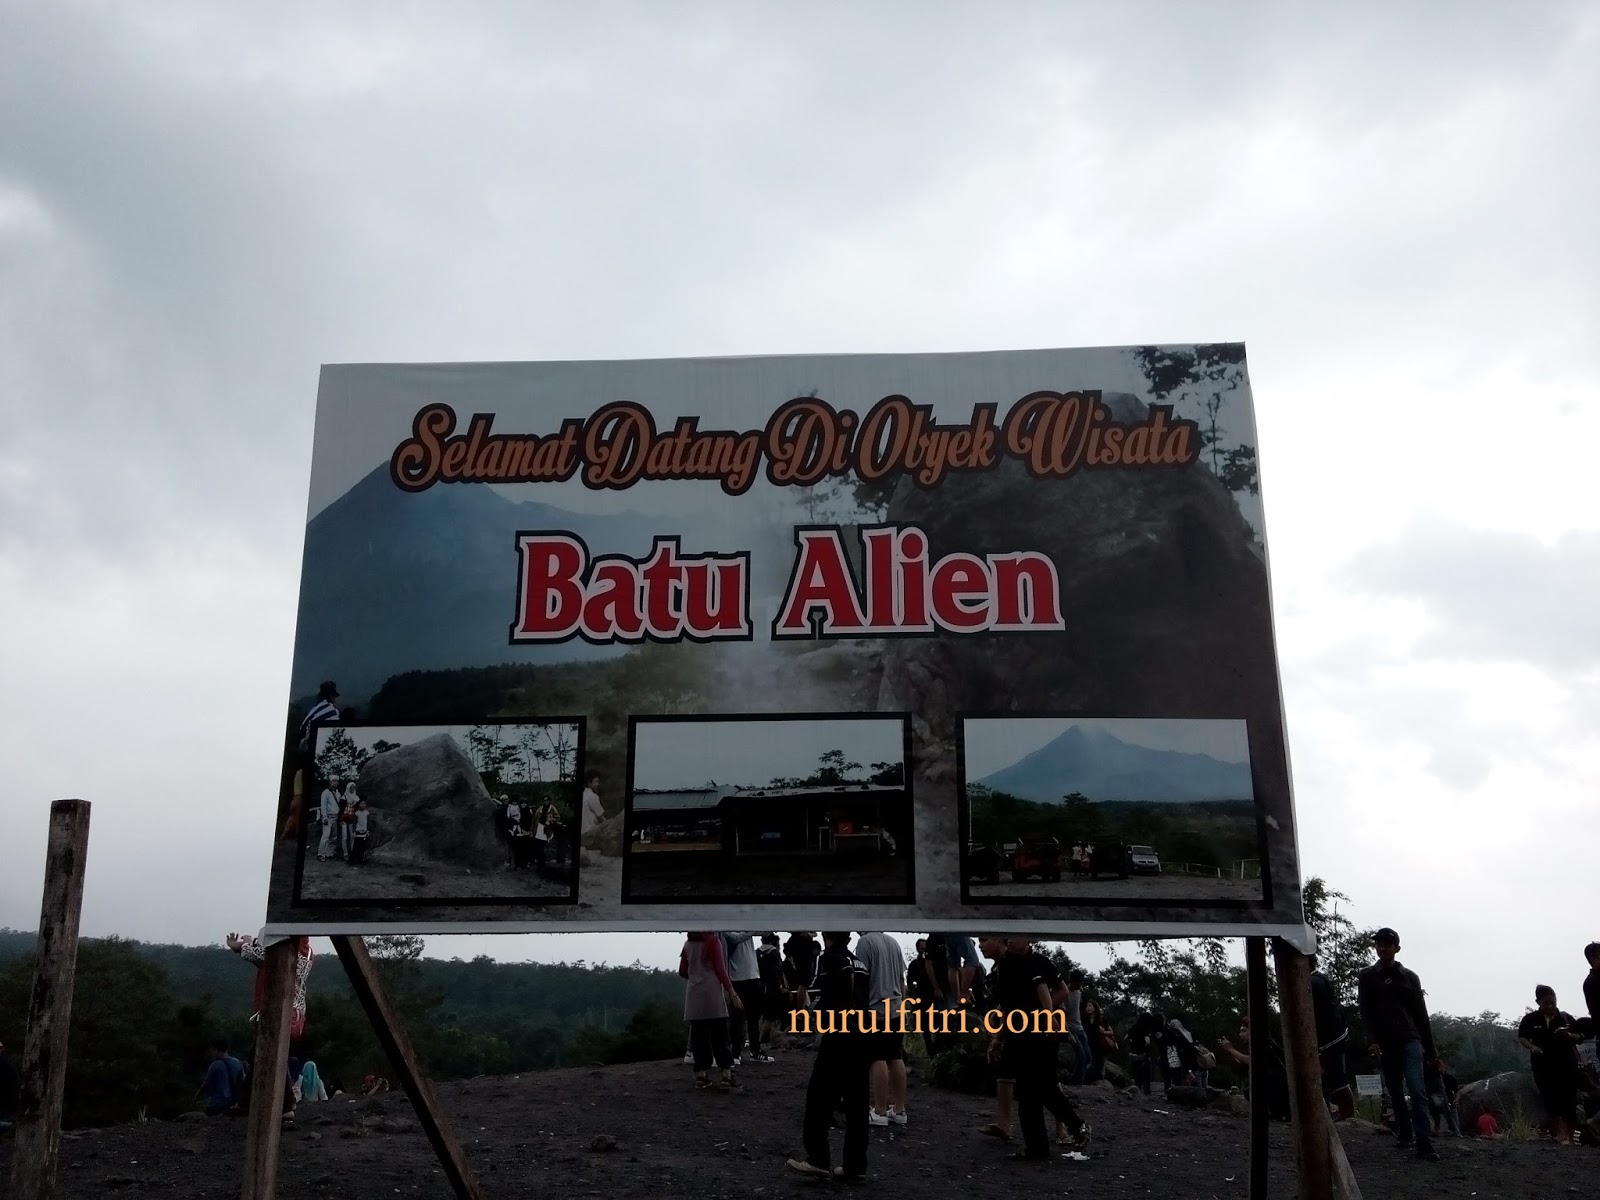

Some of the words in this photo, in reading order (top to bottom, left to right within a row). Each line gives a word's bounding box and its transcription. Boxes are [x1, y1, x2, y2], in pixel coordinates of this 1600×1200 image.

[393, 404, 584, 491] Selamat
[582, 401, 762, 495] Datang
[766, 398, 857, 485] Di
[856, 395, 998, 488] Obyek
[1003, 390, 1197, 478] Wisata
[510, 531, 752, 643] Batu
[772, 525, 1066, 638] Alien
